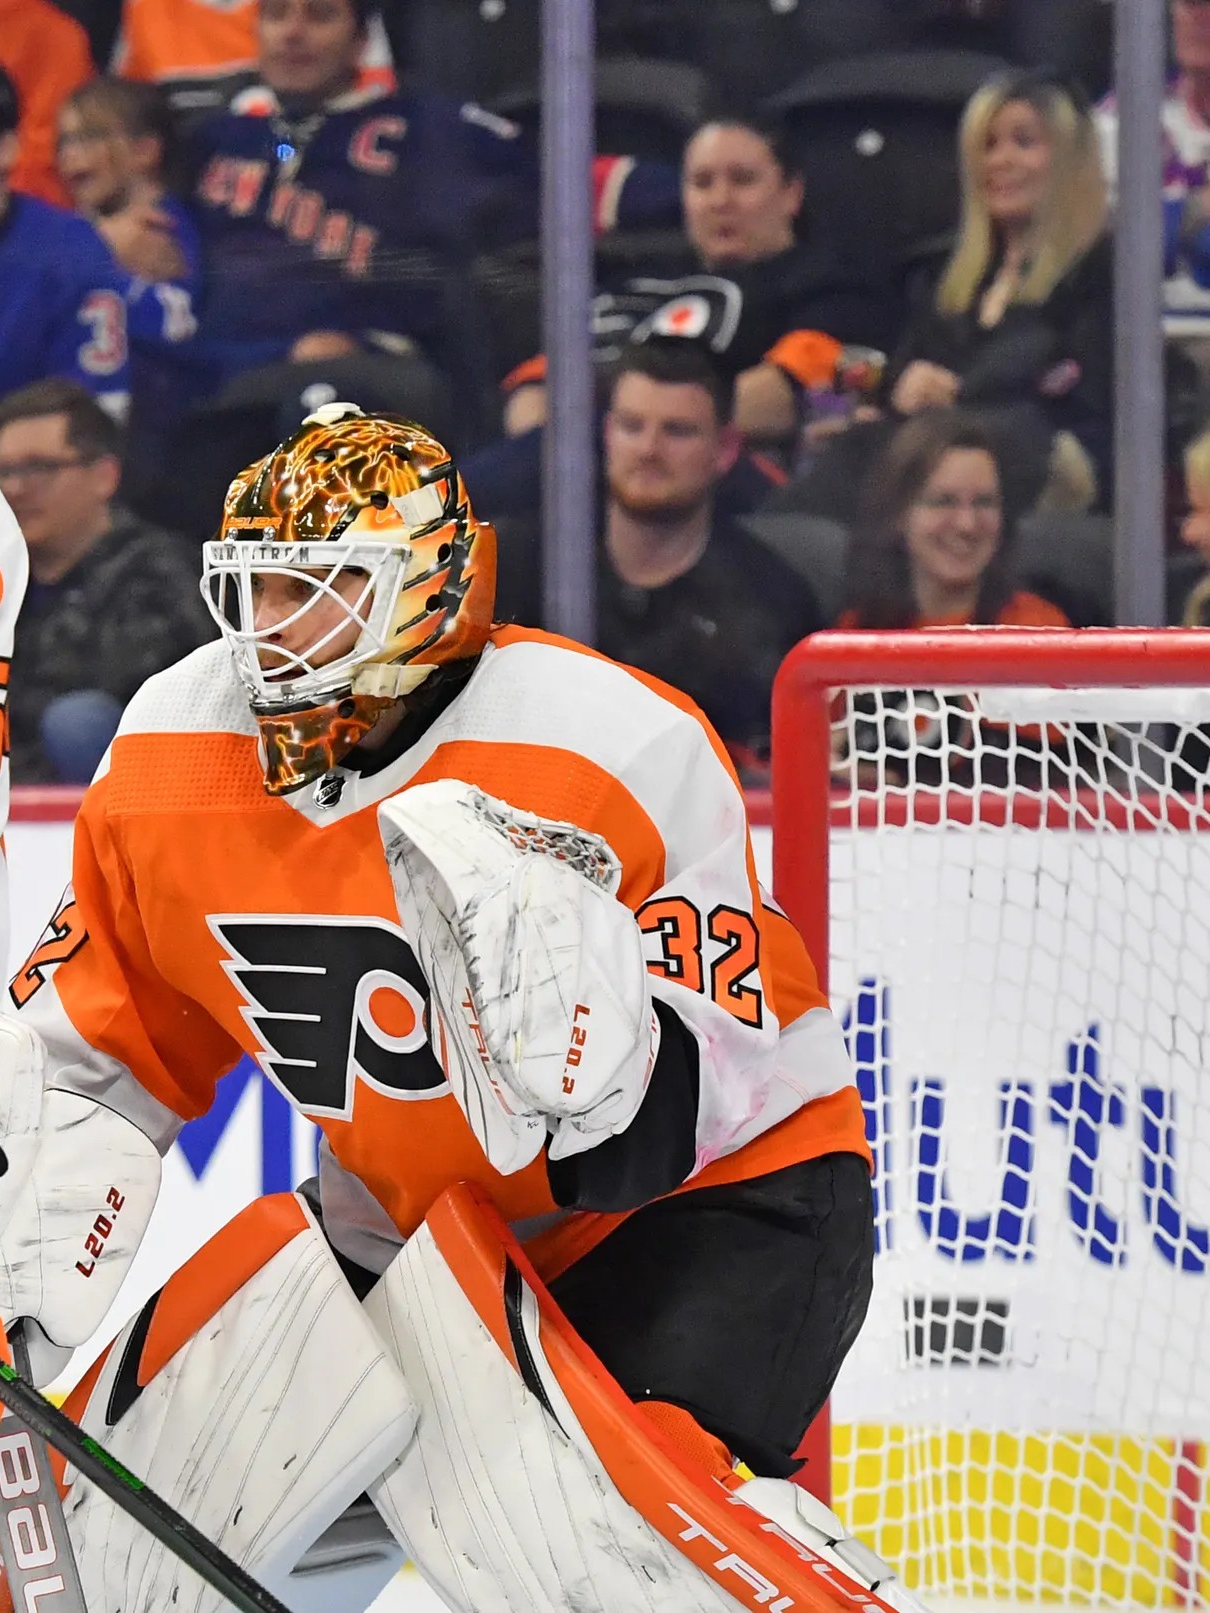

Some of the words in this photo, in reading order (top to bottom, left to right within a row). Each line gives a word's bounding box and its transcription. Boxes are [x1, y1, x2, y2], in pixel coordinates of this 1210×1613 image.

[346, 114, 408, 177] C
[77, 288, 129, 376] 3
[8, 898, 90, 1011] 2
[634, 895, 763, 1030] 32
[559, 1003, 591, 1095] L20.2
[75, 1186, 126, 1279] L20.2
